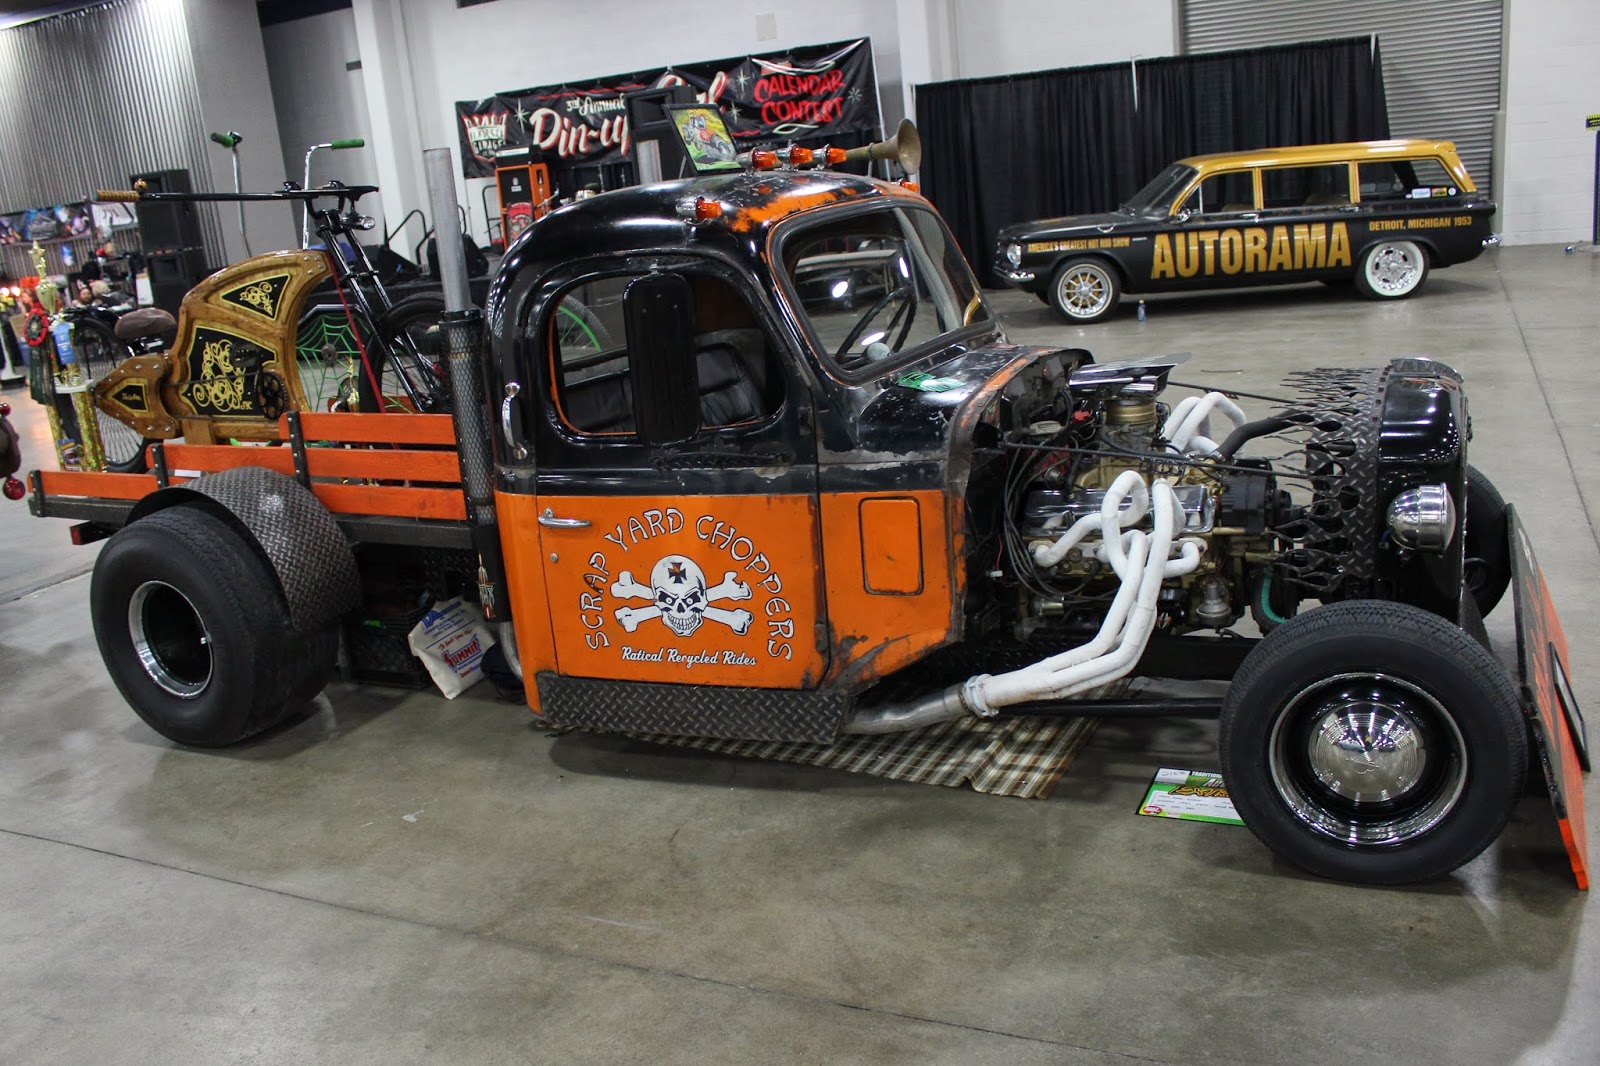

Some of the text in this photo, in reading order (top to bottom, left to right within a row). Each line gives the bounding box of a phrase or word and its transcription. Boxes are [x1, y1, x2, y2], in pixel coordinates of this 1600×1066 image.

[753, 69, 846, 103] CALENDAR
[578, 92, 626, 116] Annual
[761, 96, 844, 125] CONTEST
[1369, 216, 1472, 231] DETROIT, MICHIGAN 1953
[1059, 239, 1087, 251] GREATEST
[1151, 221, 1352, 279] AUTORAMA
[579, 507, 795, 661] SCRAP YARD CHOPPERS
[443, 639, 480, 669] SUMMIT
[620, 647, 757, 668] Ratical Recycled Rides
